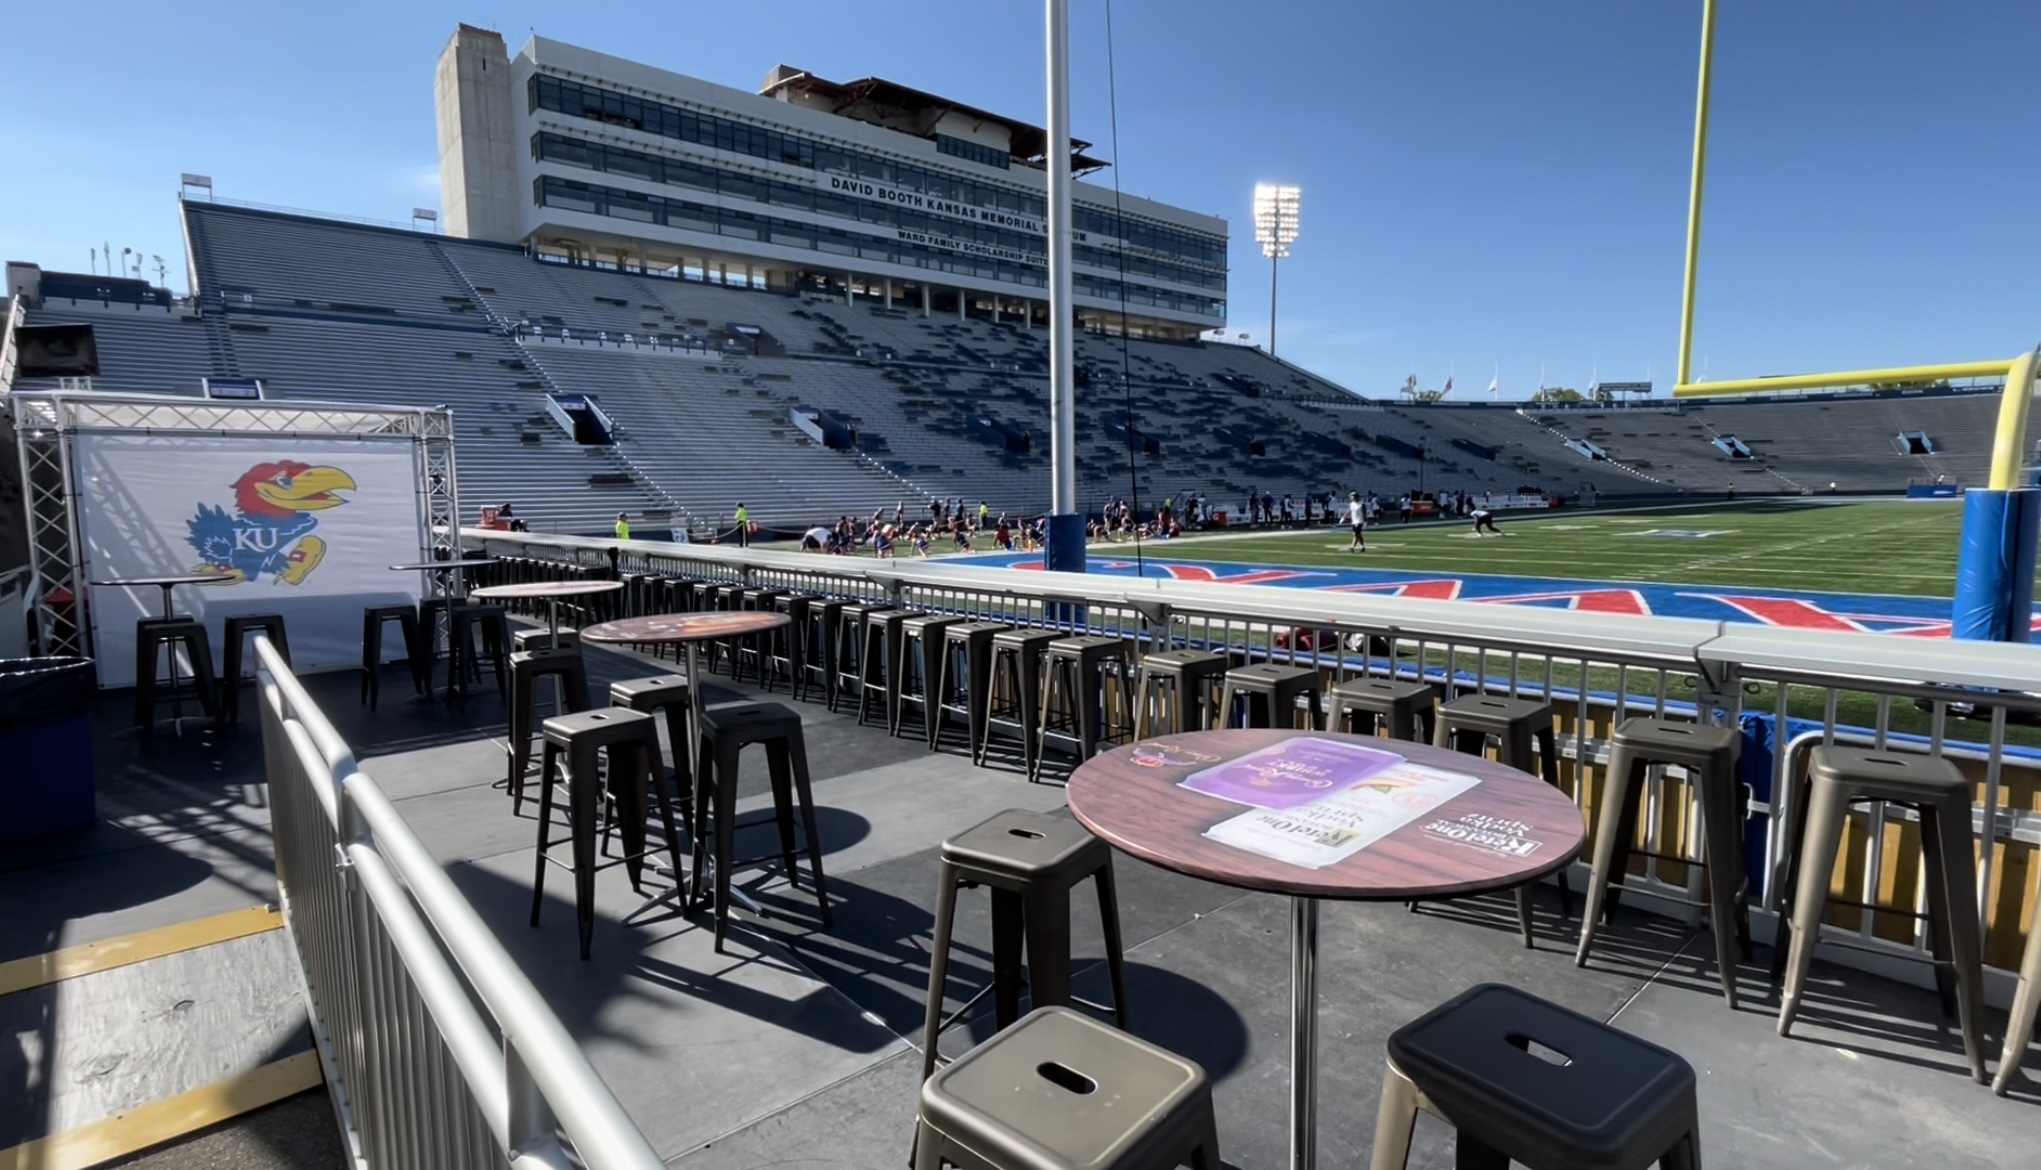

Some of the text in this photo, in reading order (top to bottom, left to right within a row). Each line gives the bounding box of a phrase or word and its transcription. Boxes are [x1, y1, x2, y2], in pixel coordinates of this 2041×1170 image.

[831, 177, 873, 196] DAVID
[878, 188, 923, 207] BOOTH
[927, 198, 977, 219] KANSAS
[981, 210, 1038, 232] MEMORIAL
[897, 231, 926, 243] WARD
[928, 236, 960, 249] FAMILY
[963, 243, 1024, 261] SCHOLARSHIP
[233, 527, 278, 552] KU
[1424, 822, 1467, 841] One
[1465, 833, 1536, 855] Ketel
